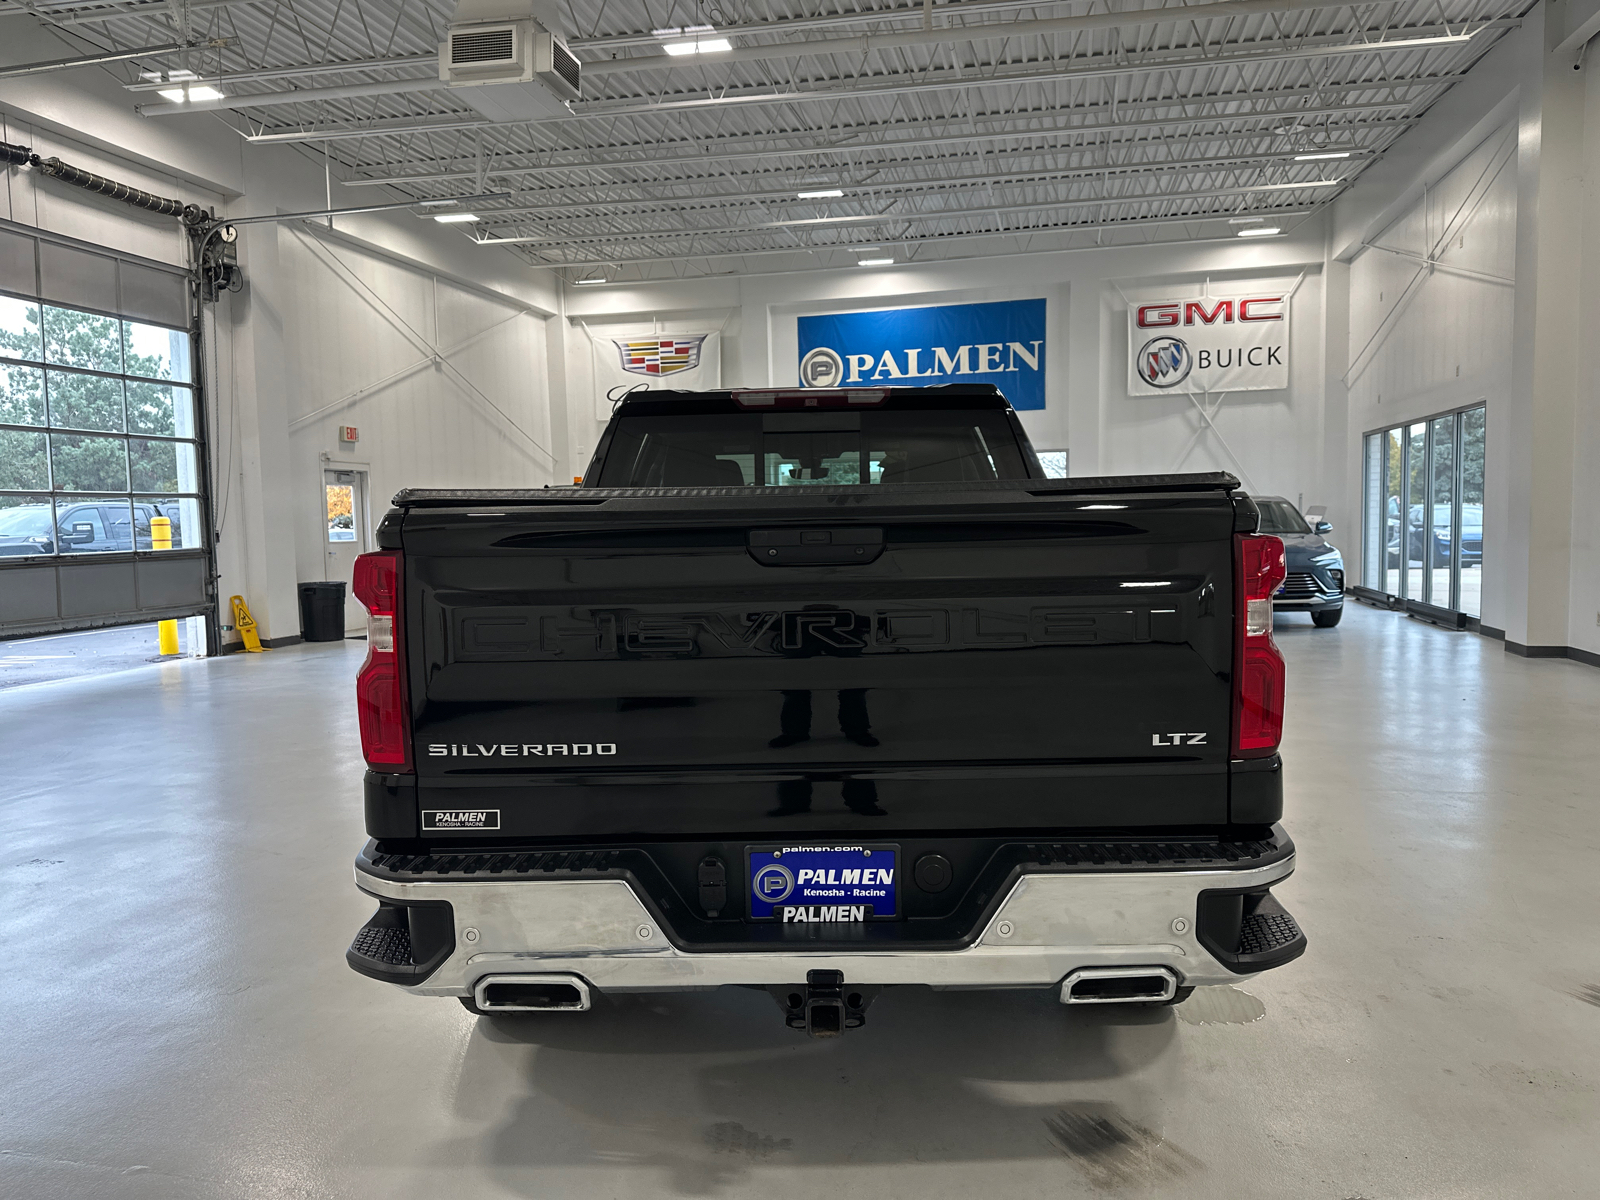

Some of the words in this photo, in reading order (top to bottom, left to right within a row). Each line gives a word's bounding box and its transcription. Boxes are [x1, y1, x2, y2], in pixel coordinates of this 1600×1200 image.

[1136, 297, 1284, 329] GMC
[845, 340, 1043, 383] PALMEN
[1198, 346, 1282, 369] BUICK
[346, 426, 357, 440] EXIT
[461, 604, 1178, 652] CHEVROLET
[1152, 732, 1207, 746] LTZ
[428, 743, 617, 757] SILVERADO
[435, 812, 486, 822] PALMEN
[782, 846, 863, 854] palmen.com
[797, 869, 894, 885] PALMEN
[803, 888, 845, 896] Kenosha
[853, 888, 886, 896] Racine
[783, 905, 865, 923] PALMEN
